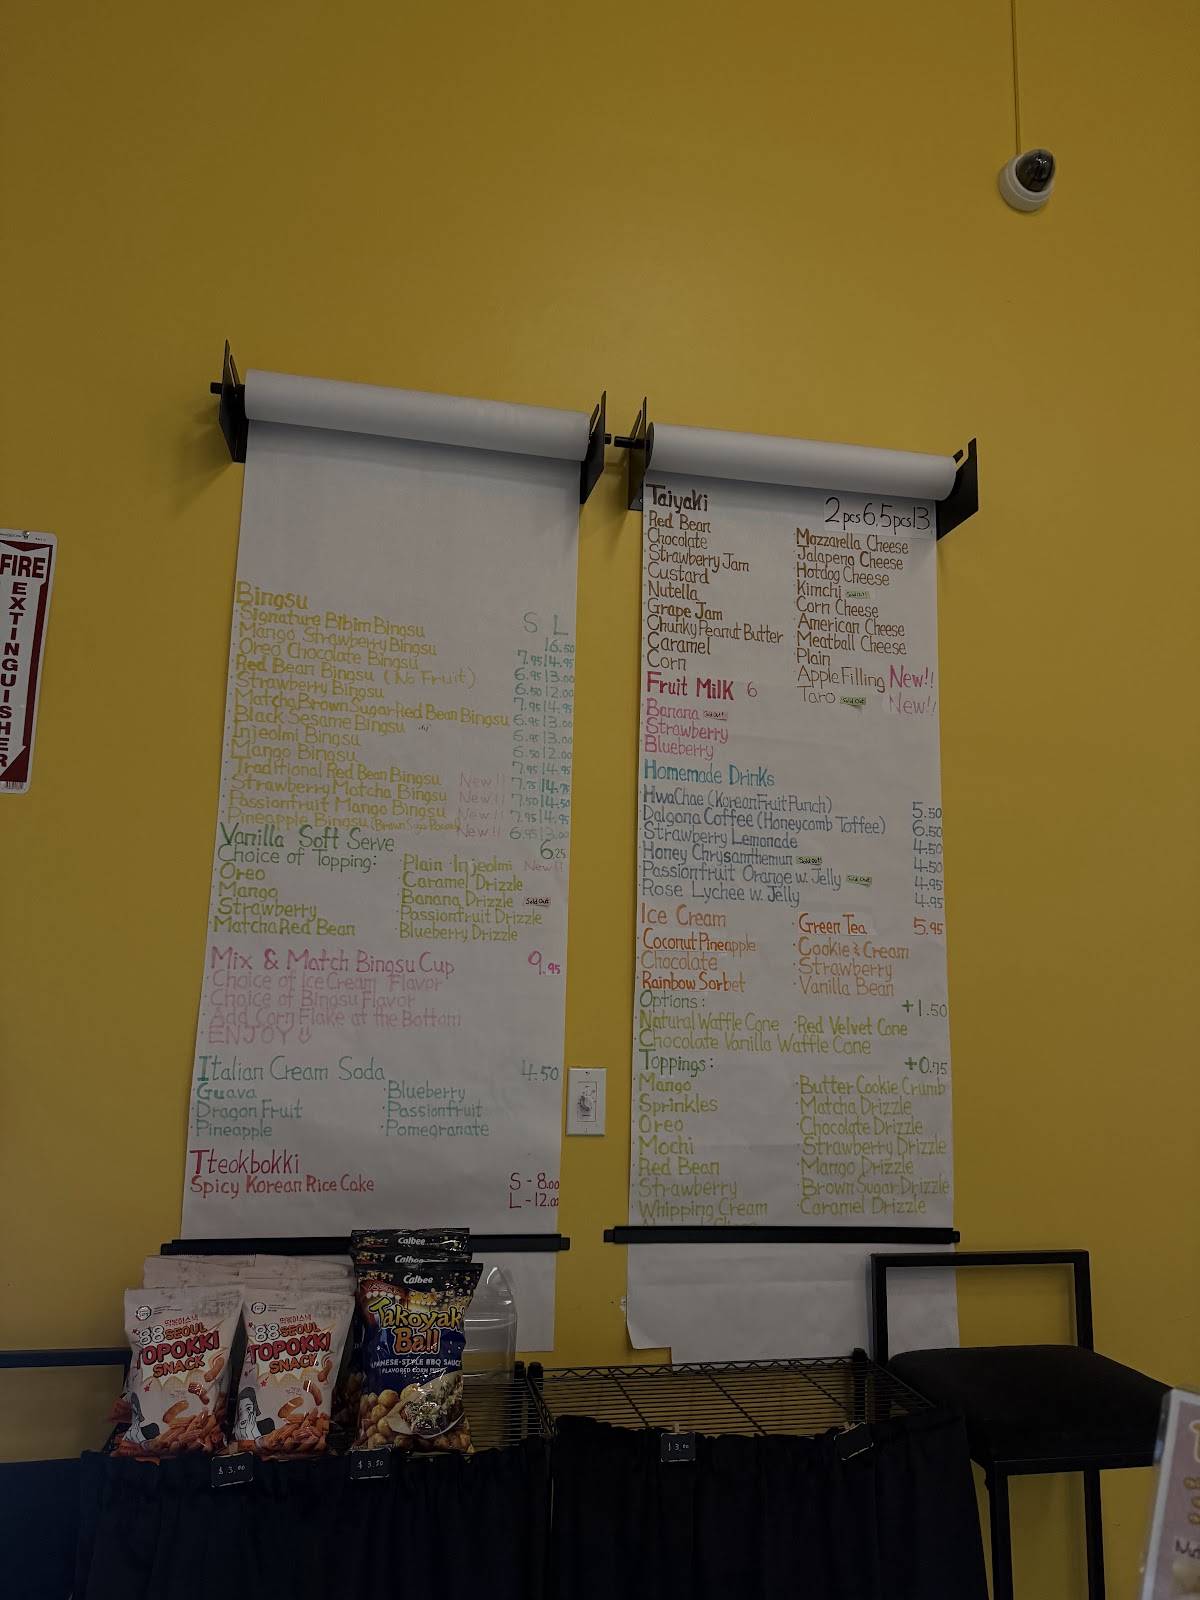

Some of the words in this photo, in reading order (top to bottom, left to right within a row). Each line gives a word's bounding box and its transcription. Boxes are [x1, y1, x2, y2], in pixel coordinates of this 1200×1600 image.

[646, 484, 708, 513] Taiyaki
[650, 510, 674, 528] Red
[679, 514, 711, 533] Bean
[648, 527, 707, 549] Chocolate
[867, 535, 909, 554] Cheese
[0, 554, 46, 578] FIRE
[650, 544, 720, 573] Strawberry
[723, 553, 750, 572] Jam
[860, 551, 904, 570] Cheese
[648, 562, 710, 584] Custard
[796, 562, 840, 584] Hotdog
[843, 566, 890, 586] Cheese
[237, 581, 308, 609] Bingsu
[648, 580, 698, 600] Nutella
[797, 579, 842, 598] Kimchi
[648, 598, 691, 621] Grape
[695, 602, 723, 620] Jam
[797, 596, 830, 614] Corn
[836, 599, 879, 618] Cheese
[374, 616, 425, 638] Bingsu
[647, 614, 697, 639] Chunky
[699, 620, 741, 639] Peanut
[744, 623, 784, 643] Butter
[798, 613, 860, 633] American
[865, 619, 905, 637] Cheese
[240, 622, 295, 642] Mango
[389, 637, 437, 656] Bingsu
[648, 632, 711, 655] Caramel
[797, 631, 855, 651] Meatball
[861, 636, 907, 655] Cheese
[288, 643, 361, 664] Chocolate
[368, 651, 418, 670] Bingsu
[647, 649, 686, 671] Corn
[797, 648, 830, 666] Plain
[236, 655, 266, 671] Red
[272, 658, 314, 675] Bean
[321, 662, 374, 682] Bingsu
[797, 665, 839, 689] Apple
[841, 667, 885, 693] Filling
[236, 671, 327, 693] Strawberry
[332, 681, 384, 701] Bingsu
[647, 671, 688, 696] Fruit
[797, 686, 836, 704] Taro
[235, 705, 283, 724] Black
[288, 708, 350, 728] Sesame
[355, 715, 405, 735] Bingsu
[460, 707, 508, 728] Bingsu
[647, 698, 698, 720] Banana
[305, 726, 360, 746] Bingsu
[645, 717, 729, 744] Strawberry
[645, 734, 714, 761] Blueberry
[390, 767, 441, 787] Bingsu
[644, 759, 722, 785] Homemade
[397, 784, 447, 804] Bingsu
[644, 804, 701, 827] Dalgona
[703, 807, 754, 828] Coffee
[220, 822, 284, 847] Vanilla
[299, 824, 339, 849] Soft
[347, 827, 394, 851] Serve
[644, 821, 727, 849] Strawberry
[732, 828, 798, 849] Lemonade
[218, 844, 280, 863] Choice
[643, 841, 687, 866] Honey
[220, 862, 266, 880] Oreo
[402, 870, 468, 889] Caramel
[643, 860, 736, 882] Passionfruit
[743, 864, 792, 887] Orange
[218, 881, 278, 900] Mango
[642, 878, 684, 897] Rose
[692, 880, 745, 903] Lychee
[218, 898, 317, 921] Strawberry
[641, 902, 668, 925] Ice
[676, 904, 726, 928] Cream
[316, 918, 356, 936] Bean
[799, 913, 840, 934] Green
[843, 914, 867, 935] Tea
[643, 928, 697, 950] Coconut
[211, 946, 252, 970] Mix
[286, 949, 349, 972] Match
[356, 950, 416, 976] Bingsu
[419, 952, 455, 979] Cup
[641, 950, 718, 971] Chocolate
[799, 956, 893, 982] Strawberry
[643, 970, 696, 991] Rainbow
[698, 971, 746, 993] Sorbet
[799, 975, 850, 996] Vanilla
[197, 1056, 263, 1082] Italian
[270, 1055, 328, 1081] Cream
[338, 1056, 385, 1081] Soda
[196, 1082, 257, 1100] Guava
[388, 1080, 465, 1102] Blueberry
[639, 1072, 692, 1094] Mango
[197, 1101, 257, 1121] Dragon
[387, 1099, 483, 1118] Passionfruit
[639, 1093, 718, 1116] Sprinkles
[196, 1119, 272, 1140] Pineapple
[386, 1119, 490, 1139] Pomegranate
[639, 1114, 683, 1134] Oreo
[638, 1135, 694, 1155] Mochi
[190, 1149, 299, 1175] Tteokbokki
[190, 1175, 239, 1199] Spicy
[246, 1176, 301, 1194] Korean
[306, 1174, 337, 1193] Rice
[340, 1173, 374, 1193] Cake
[398, 1237, 426, 1246] Calbee
[403, 1273, 434, 1284] Calbee
[369, 1296, 465, 1332] Takoyak
[165, 1322, 208, 1340] SEOUL
[280, 1321, 321, 1337] SEOUL
[392, 1327, 440, 1354] Ball
[247, 1332, 331, 1364] TOPOKKI
[153, 1354, 206, 1378] SNACK
